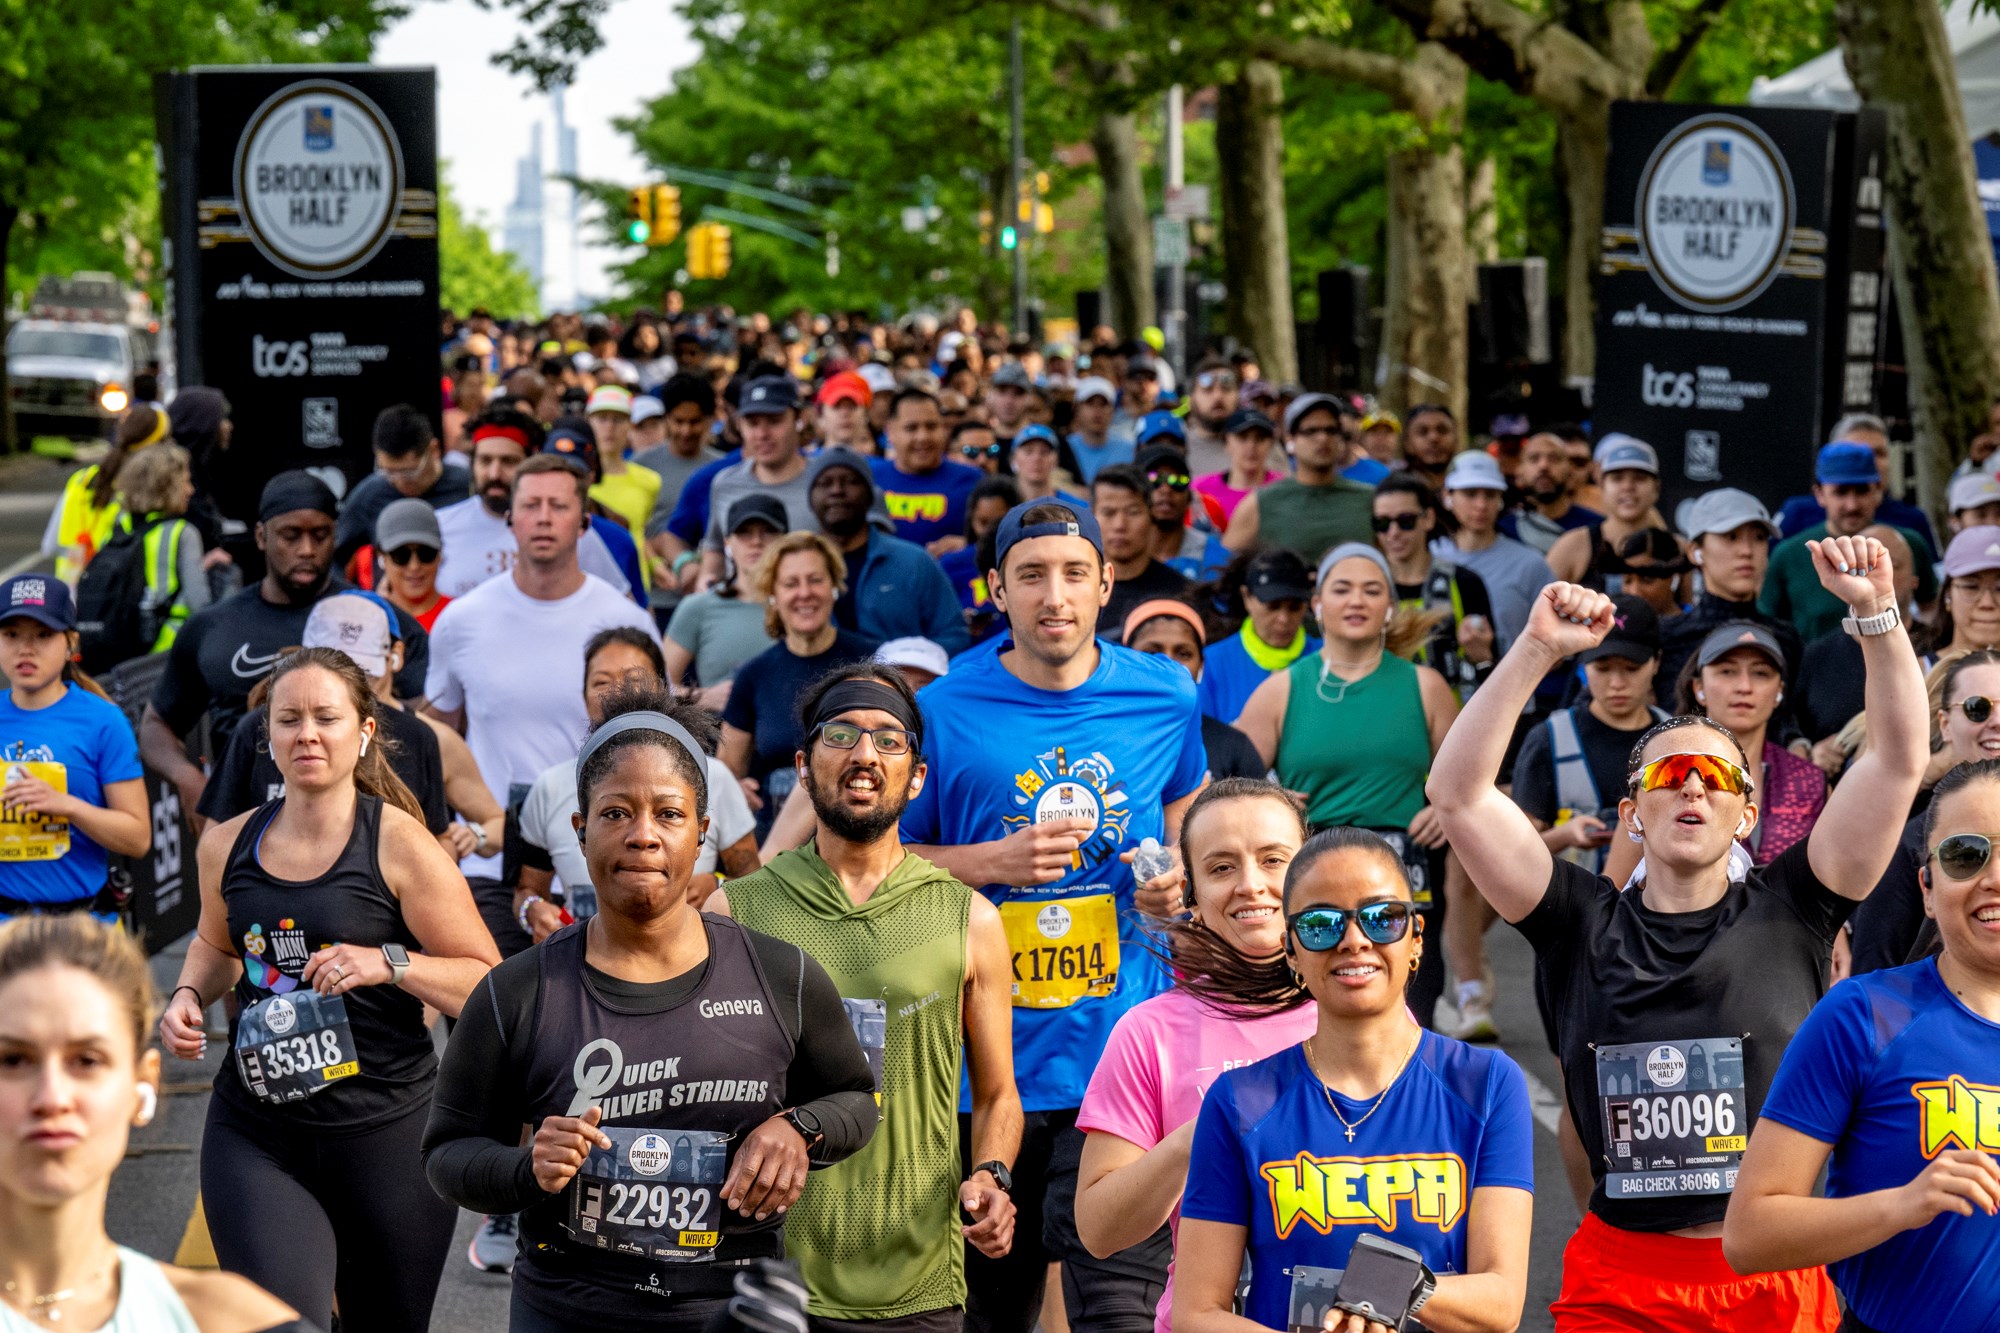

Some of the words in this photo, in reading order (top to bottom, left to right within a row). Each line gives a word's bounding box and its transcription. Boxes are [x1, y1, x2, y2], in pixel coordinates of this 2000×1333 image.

[256, 164, 381, 193] BROOKLYN
[289, 198, 349, 227] HALF
[1657, 195, 1772, 228] BROOKLYN
[1684, 229, 1740, 260] HALF
[253, 334, 309, 377] tcs
[1642, 363, 1695, 408] tcs
[1039, 917, 1069, 925] BROOKLYN
[272, 937, 309, 962] MINI
[1029, 942, 1105, 981] 17614
[267, 1009, 293, 1021] BROOKLYN
[700, 999, 763, 1018] Geneva
[898, 991, 940, 1018] NELEUS
[273, 1018, 287, 1026] HALF
[262, 1029, 342, 1079] 35318
[1649, 1062, 1684, 1071] BROOKLYN
[328, 1065, 347, 1077] WAVE
[347, 1064, 353, 1073] 2
[572, 1038, 681, 1099] QUICK
[1657, 1070, 1675, 1078] HALF
[669, 1080, 768, 1106] STRIDERS
[1610, 1103, 1631, 1140] F
[1632, 1093, 1735, 1140] 36096
[631, 1150, 669, 1160] BROOKLYN
[1712, 1139, 1732, 1149] WAVE
[1734, 1138, 1741, 1148] 2
[640, 1159, 659, 1168] HALF
[1261, 1152, 1466, 1238] WEPA
[1622, 1178, 1643, 1193] BAG
[1645, 1176, 1678, 1191] CHECK
[1679, 1172, 1720, 1190] 36096
[580, 1180, 602, 1217] F
[606, 1183, 711, 1231] 22932
[685, 1233, 705, 1244] WAVE
[706, 1234, 712, 1244] 2
[635, 1283, 672, 1297] FLIPBELT
